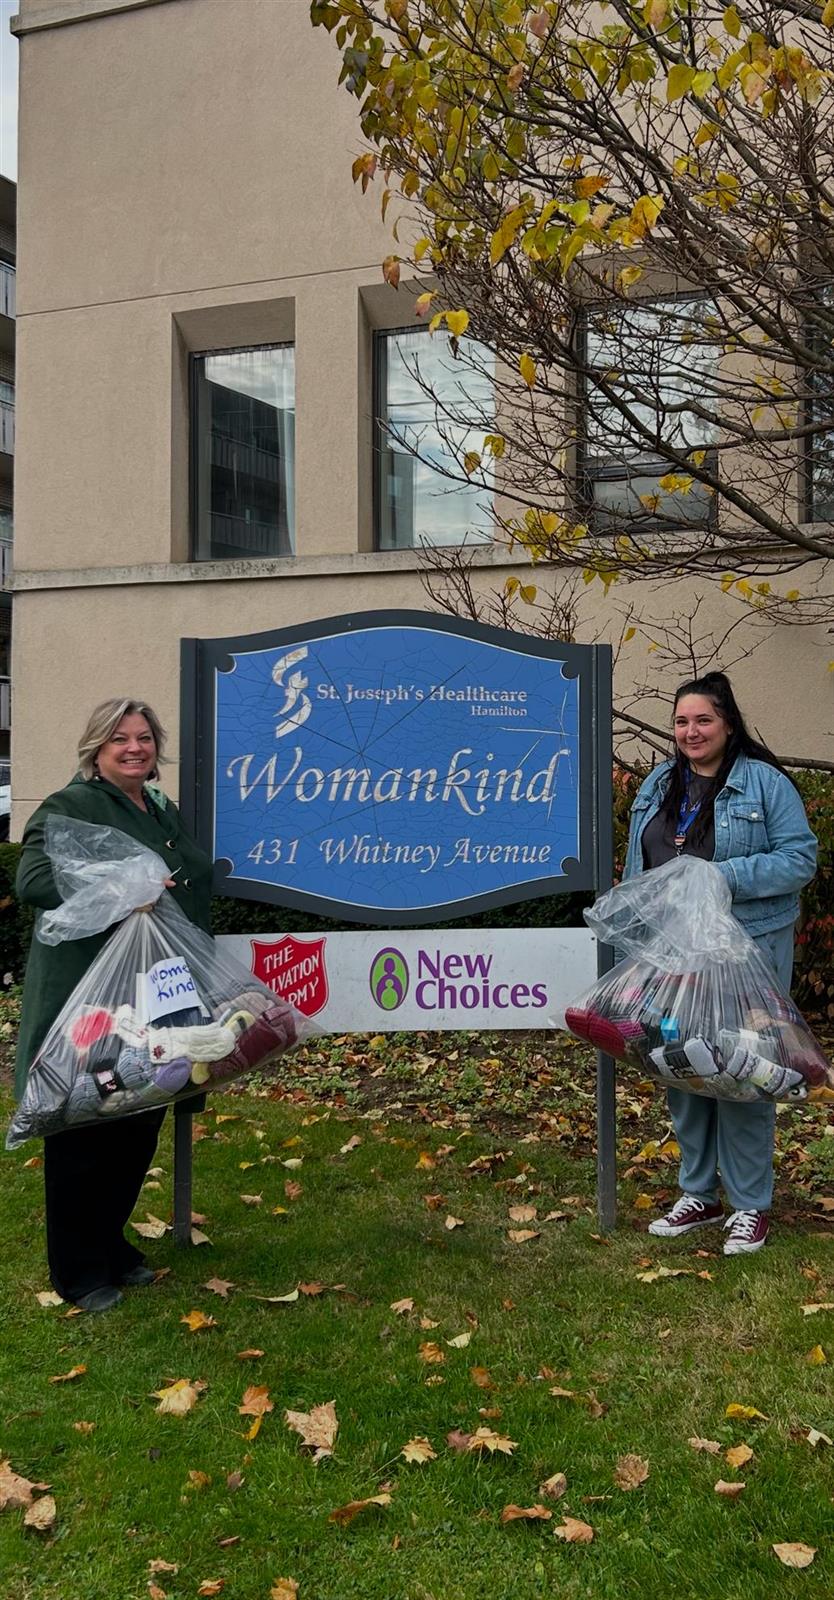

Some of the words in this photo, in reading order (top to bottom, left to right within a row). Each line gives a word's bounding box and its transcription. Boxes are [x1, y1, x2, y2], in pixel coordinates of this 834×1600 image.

[316, 684, 340, 700] St.
[345, 684, 424, 704] Joseph's
[429, 685, 528, 702] Healthcare
[471, 705, 528, 716] Hamilton
[226, 747, 571, 816] Womankind
[247, 839, 299, 865] 431
[319, 834, 441, 873] Whitney
[444, 838, 551, 867] Avenue
[263, 944, 294, 974] THE
[417, 949, 493, 979] New
[283, 976, 319, 1008] RMY
[415, 978, 548, 1010] Choices
